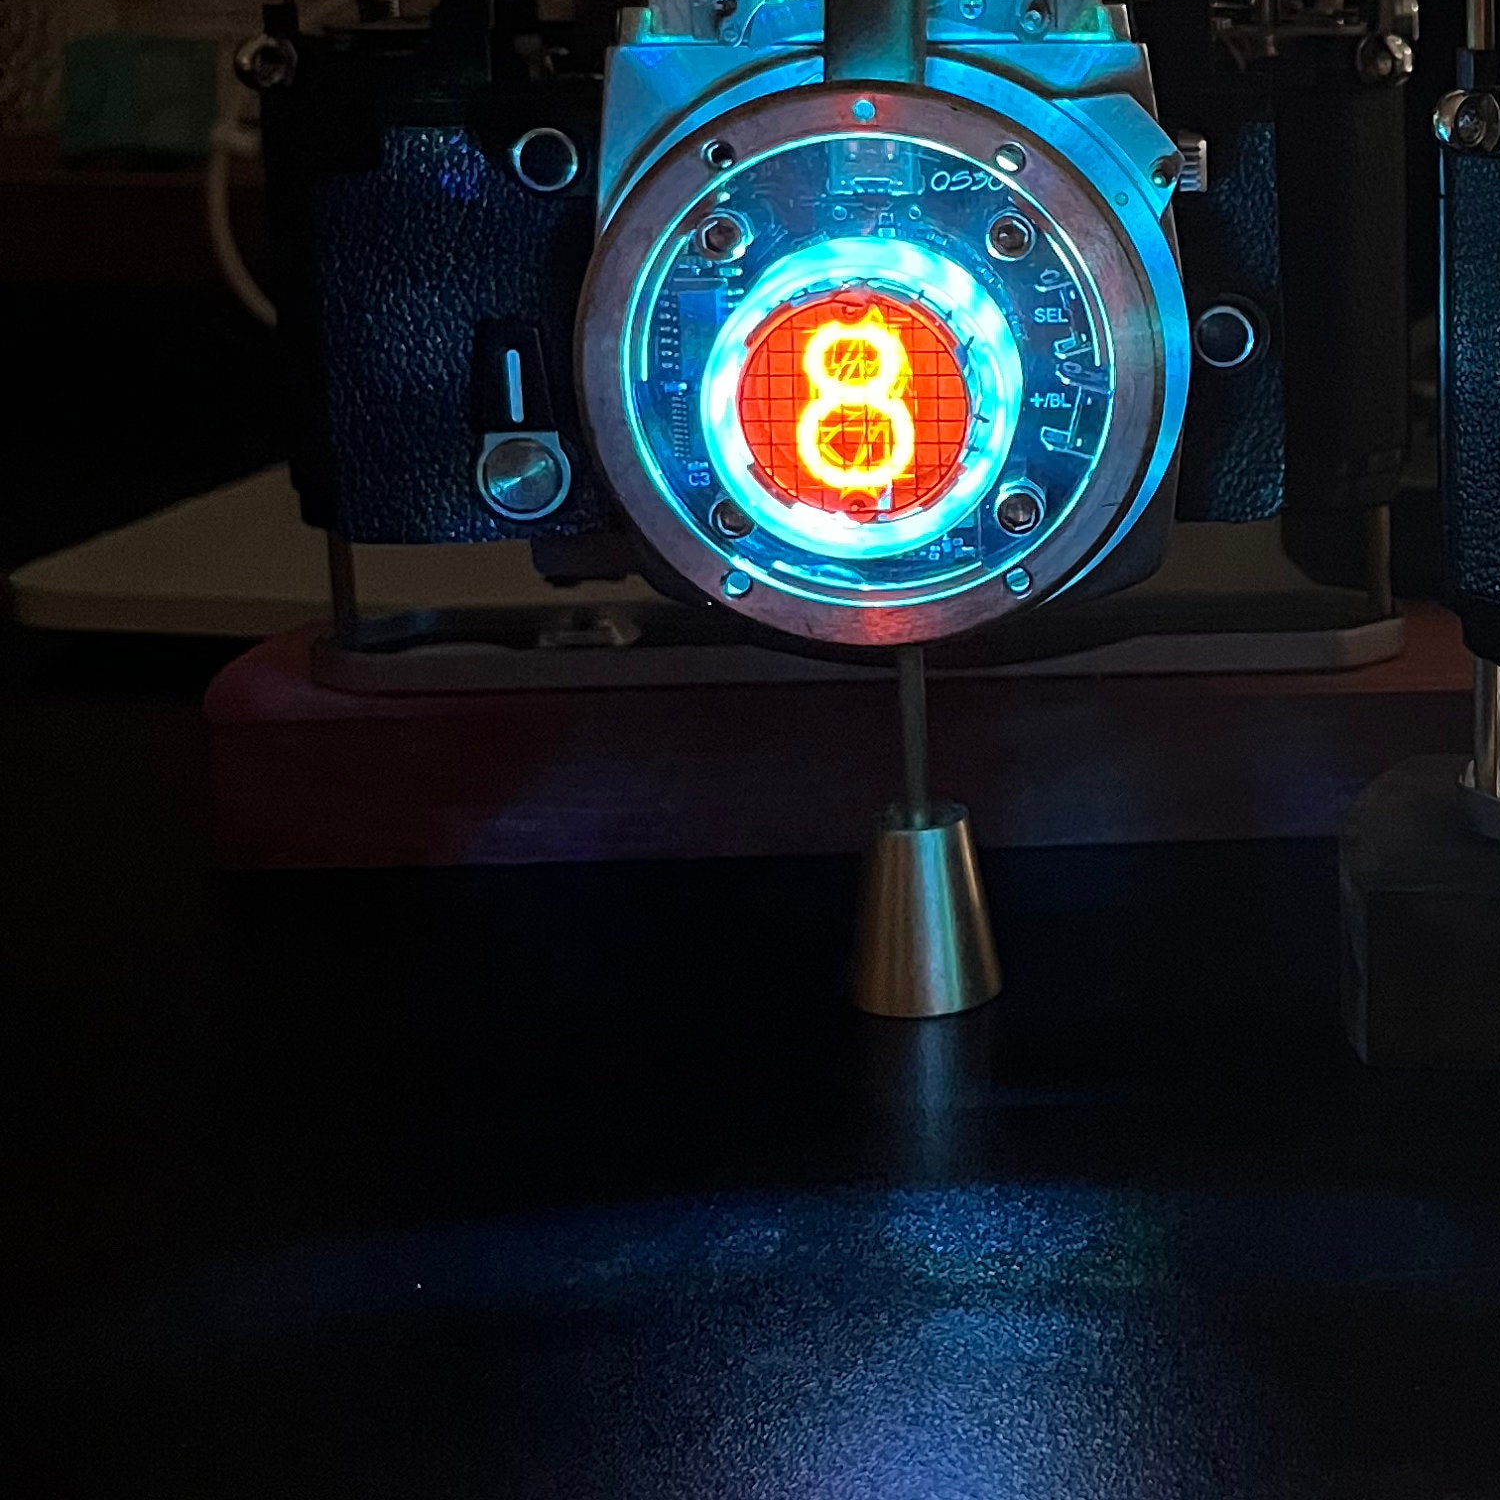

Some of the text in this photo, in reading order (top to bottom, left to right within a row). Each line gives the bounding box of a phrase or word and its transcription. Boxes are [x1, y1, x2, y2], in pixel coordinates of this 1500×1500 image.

[1033, 307, 1069, 323] SEL
[796, 320, 915, 489] 8
[1029, 392, 1072, 408] +/BL
[688, 471, 711, 487] C3
